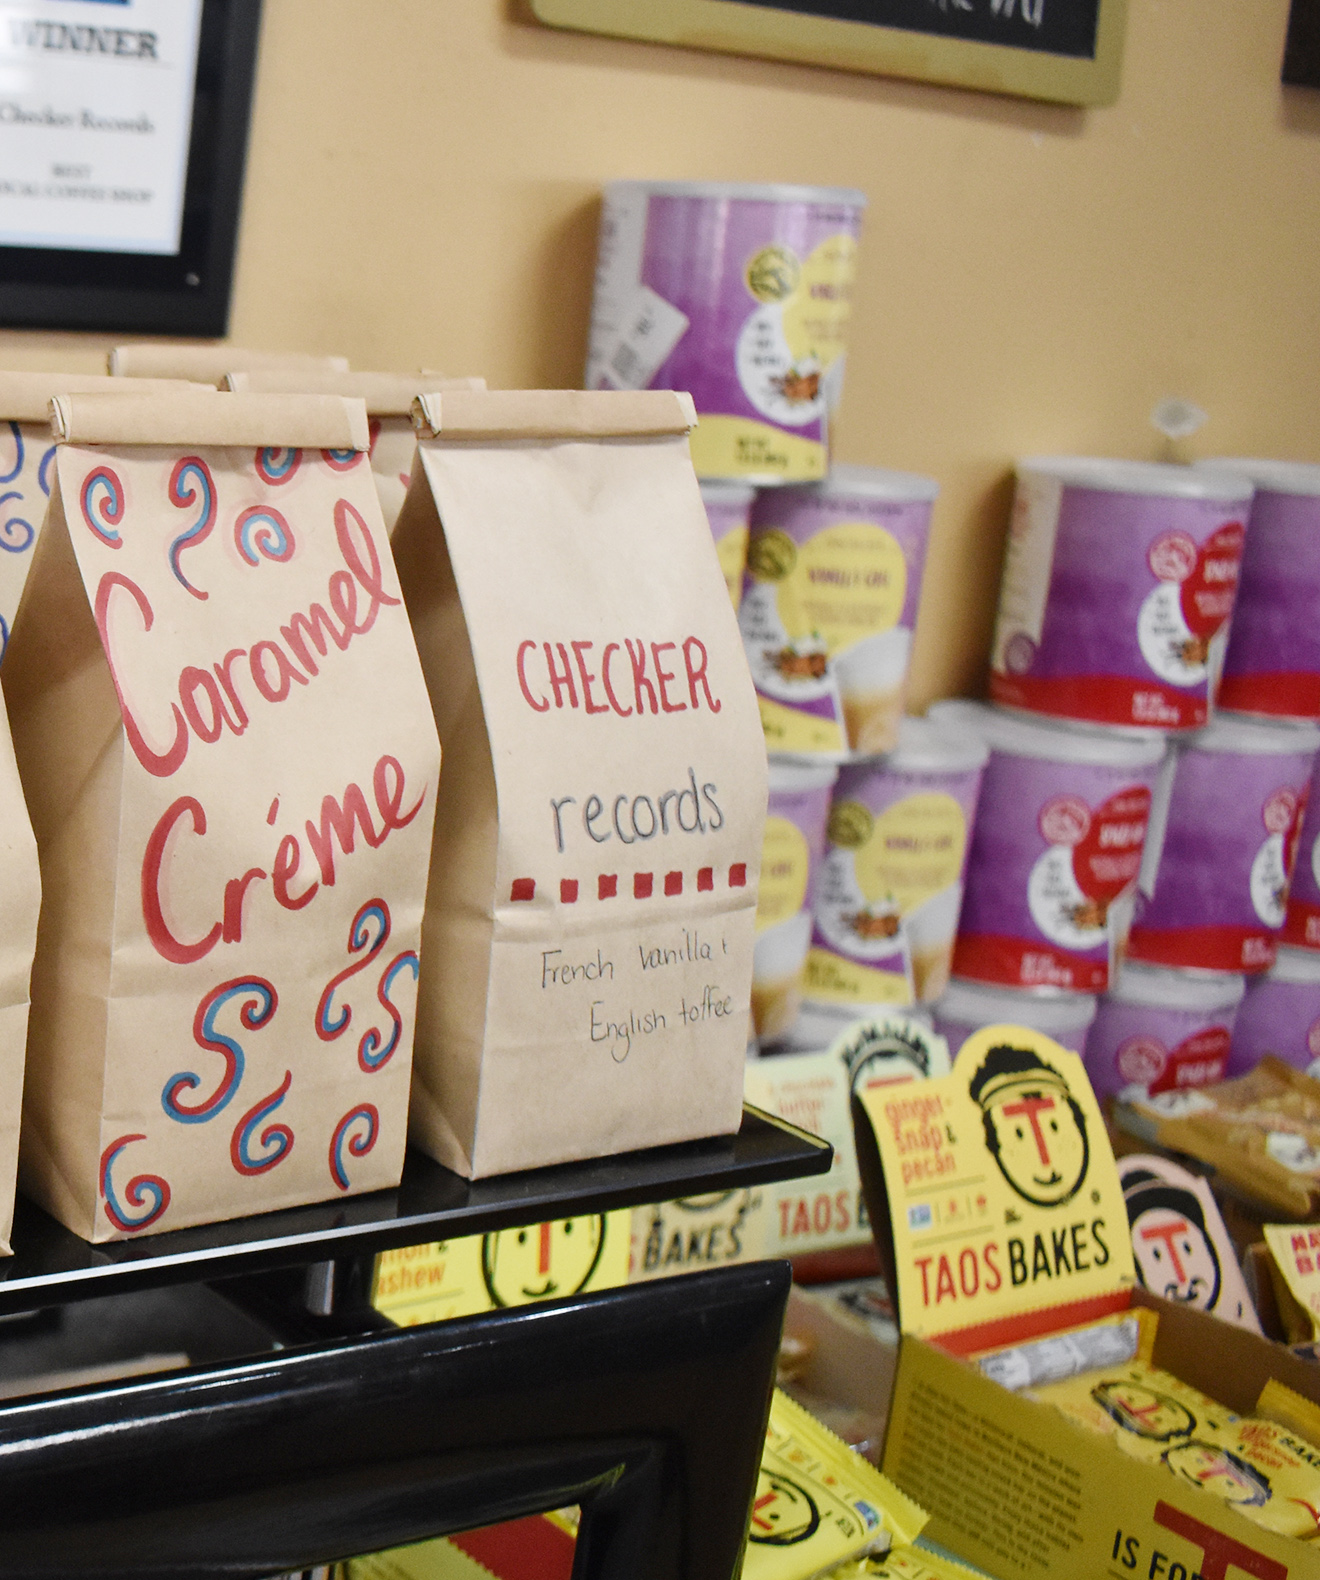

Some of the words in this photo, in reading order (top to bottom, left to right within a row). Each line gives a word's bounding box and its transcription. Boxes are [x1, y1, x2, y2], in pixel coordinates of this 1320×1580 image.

[8, 19, 159, 60] WINNER
[94, 498, 402, 778] Caramel
[516, 635, 722, 718] CHECKER
[549, 767, 725, 853] records
[541, 948, 615, 988] French
[590, 1000, 667, 1063] English
[678, 984, 734, 1026] toffee
[779, 1190, 851, 1238] TAOS
[914, 1241, 1003, 1308] TAOS
[1007, 1218, 1110, 1288] BAKES
[1112, 1528, 1141, 1570] IS
